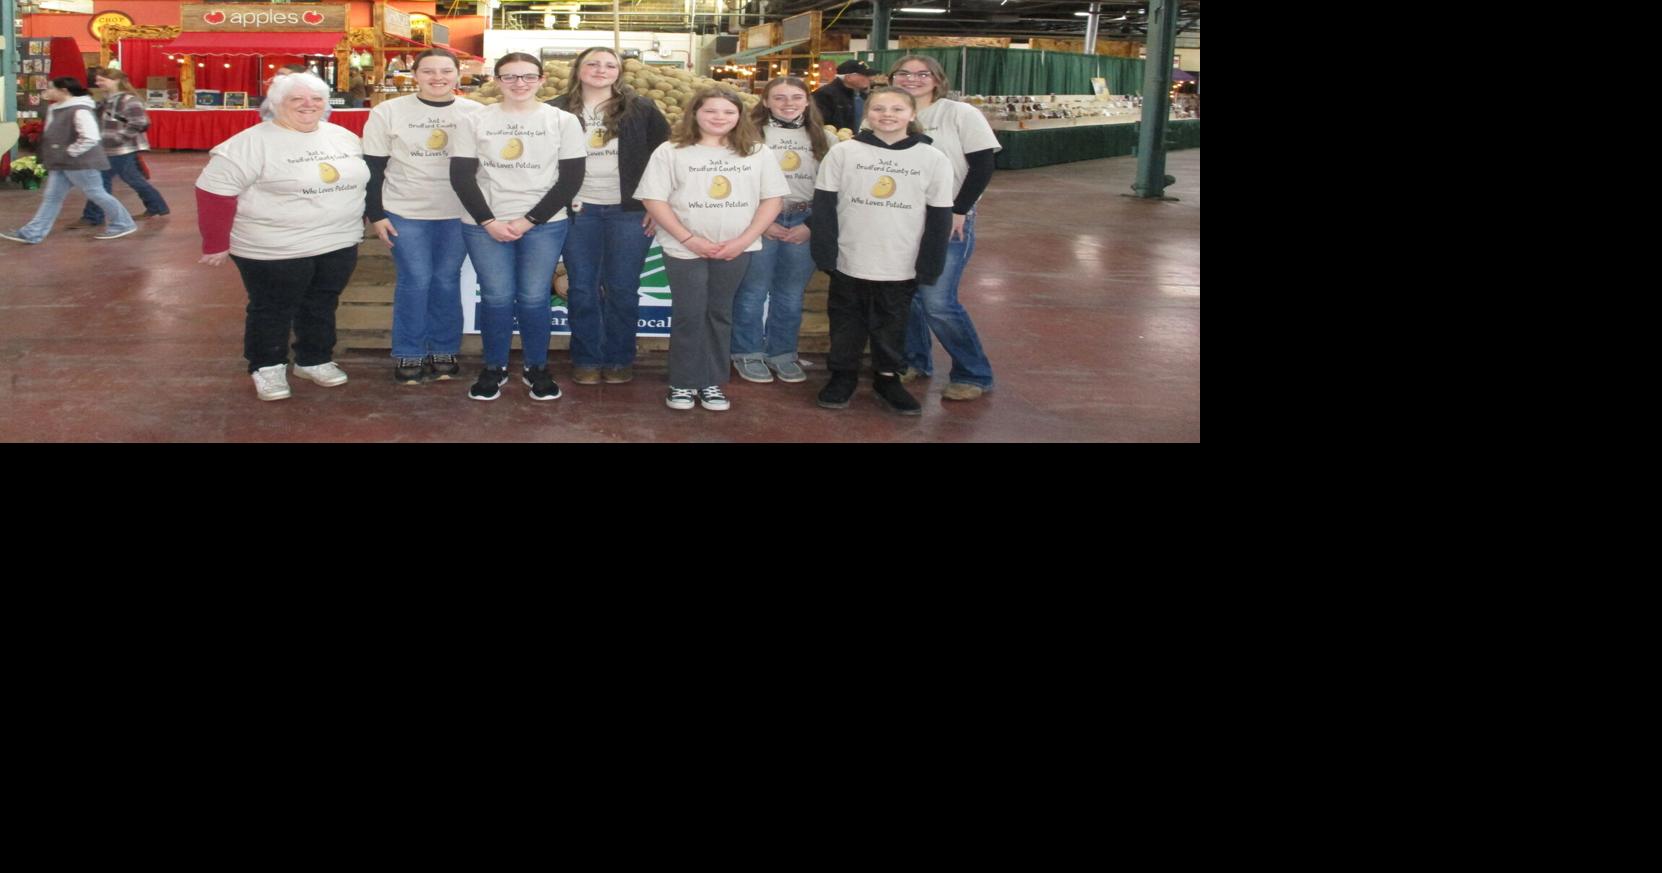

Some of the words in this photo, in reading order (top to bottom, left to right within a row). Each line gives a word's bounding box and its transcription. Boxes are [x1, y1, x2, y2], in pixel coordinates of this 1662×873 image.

[230, 8, 299, 28] apples
[719, 165, 741, 173] County
[856, 163, 885, 172] Bradford
[886, 166, 909, 176] County
[851, 196, 864, 204] Who
[865, 198, 884, 207] Loves
[637, 316, 672, 328] ocal
